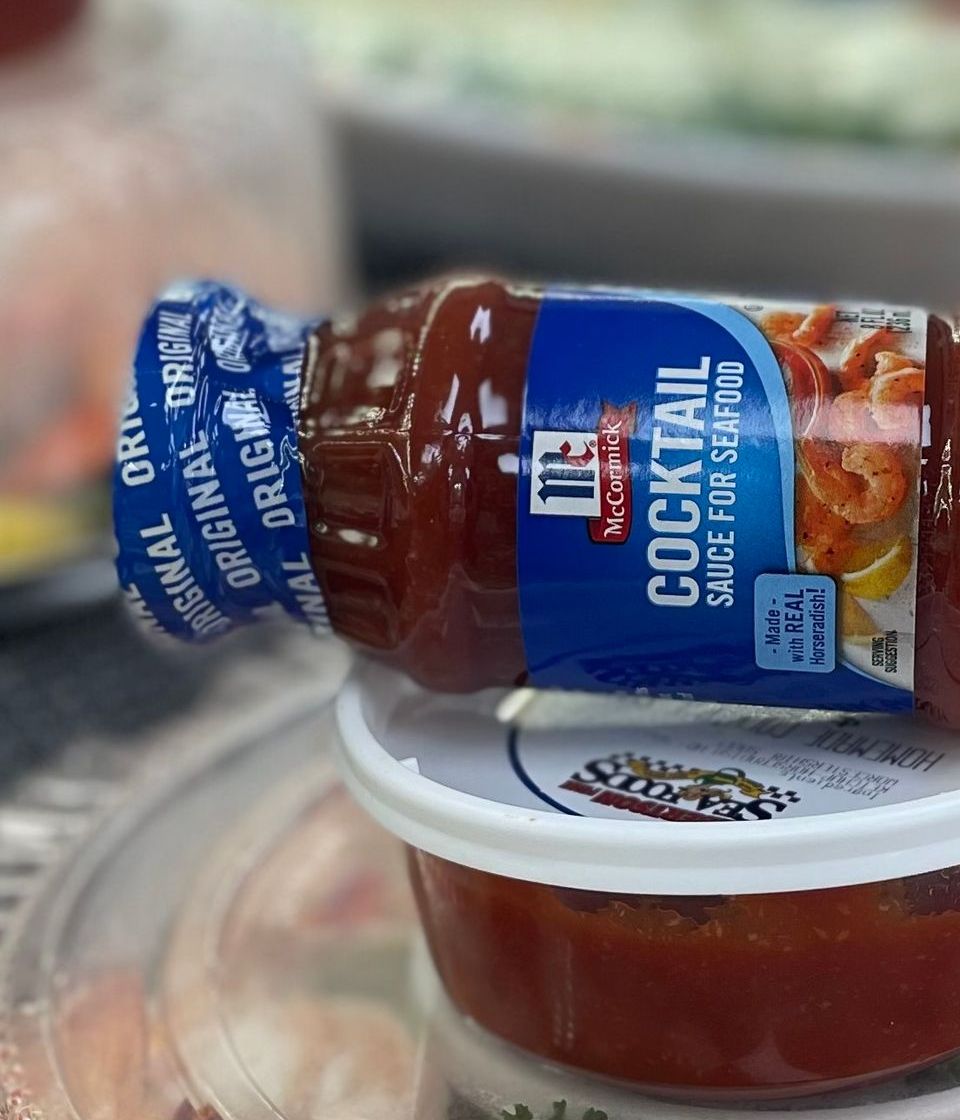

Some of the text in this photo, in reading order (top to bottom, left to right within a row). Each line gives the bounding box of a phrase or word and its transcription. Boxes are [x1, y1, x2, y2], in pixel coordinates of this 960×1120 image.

[157, 311, 196, 408] ORIGINAL
[222, 388, 295, 528] ORIGINAL
[602, 420, 625, 537] McCormick
[647, 356, 710, 607] COCKTAIL
[708, 361, 744, 607] SAUCE FOR SEAFOOD
[179, 429, 261, 588] ORIGINAL
[784, 589, 804, 663] with REAL
[805, 588, 826, 665] Horseradish!
[872, 637, 884, 667] SERVING
[885, 629, 897, 673] SUGGESTION
[571, 758, 681, 804] FOODS
[697, 794, 787, 820] SEA
